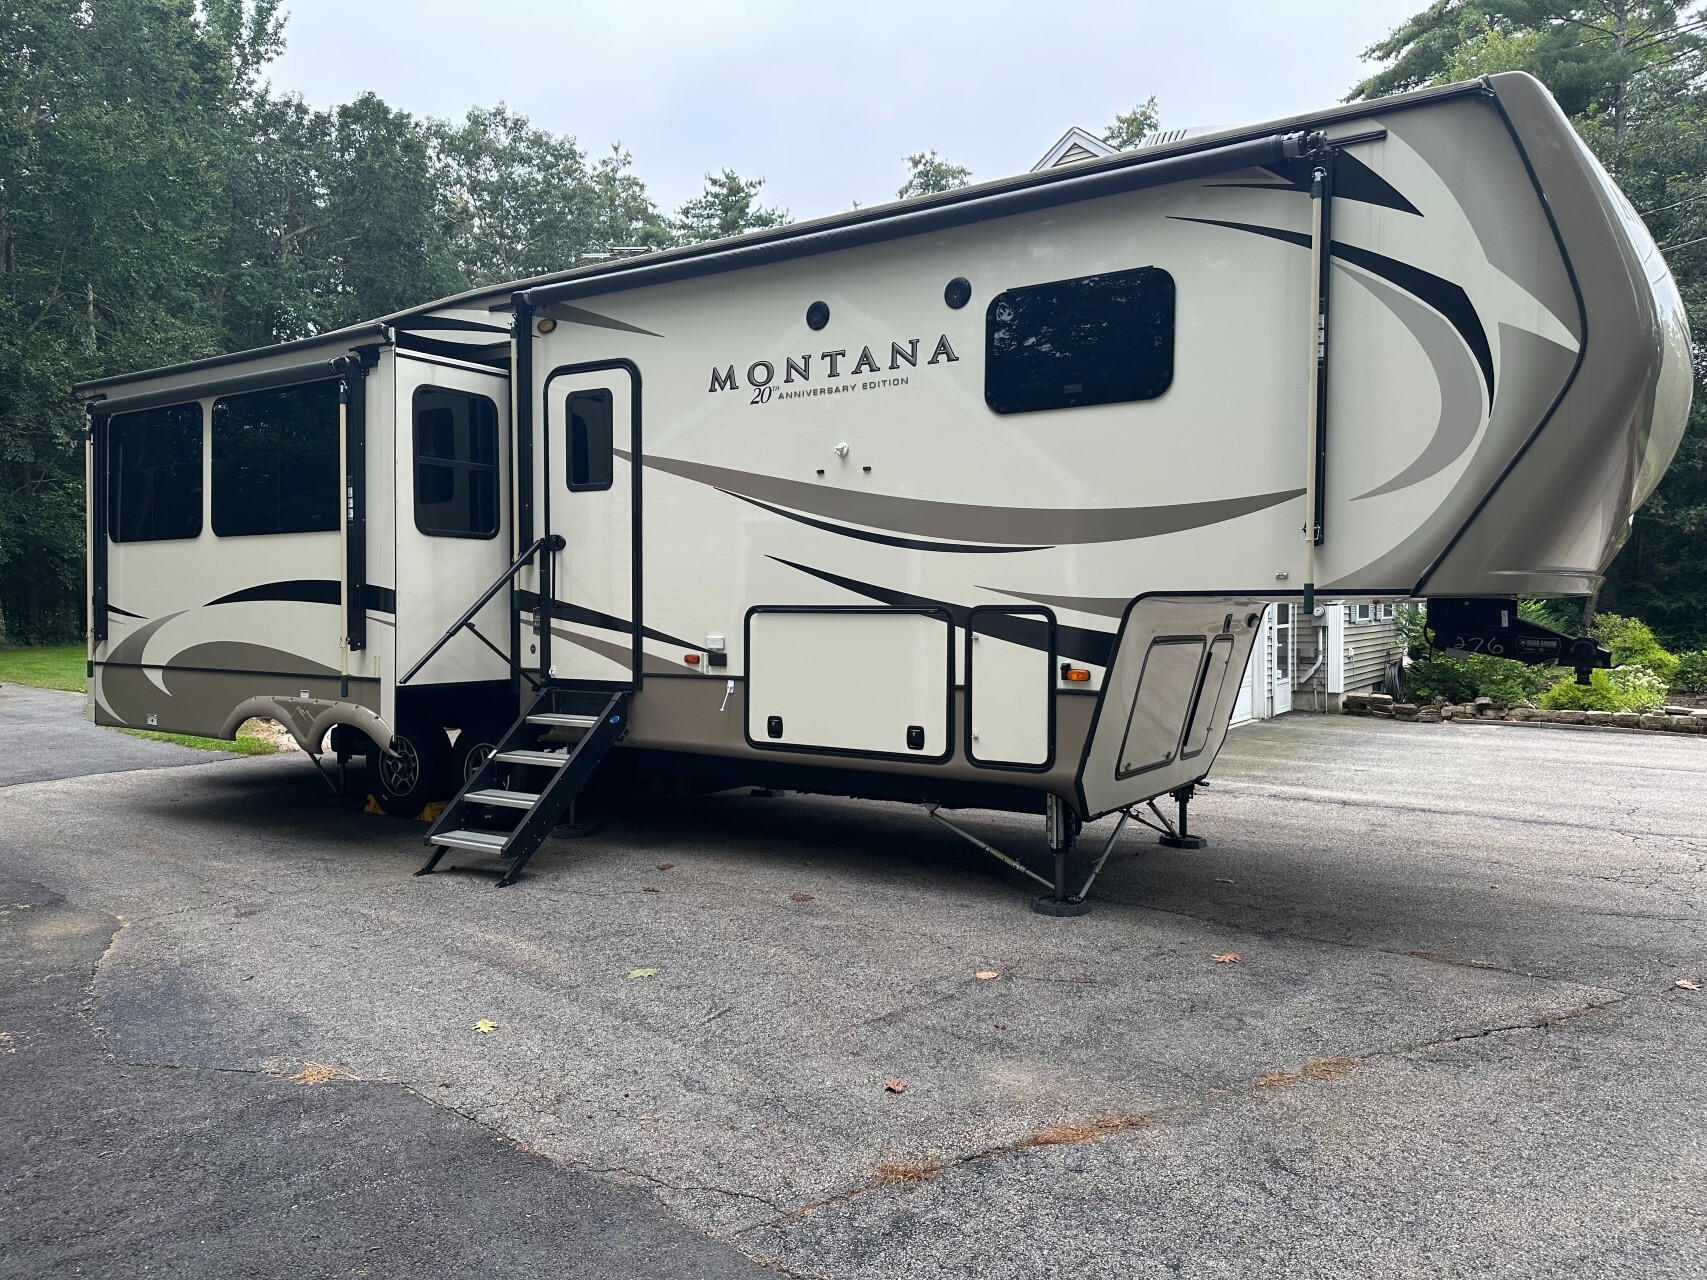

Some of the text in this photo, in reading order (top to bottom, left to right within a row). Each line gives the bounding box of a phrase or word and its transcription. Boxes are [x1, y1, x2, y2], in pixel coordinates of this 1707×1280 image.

[707, 333, 960, 394] MONTANA
[777, 383, 857, 401] ANNIVERSARY
[862, 376, 909, 392] EDITION
[1453, 636, 1504, 655] 276
